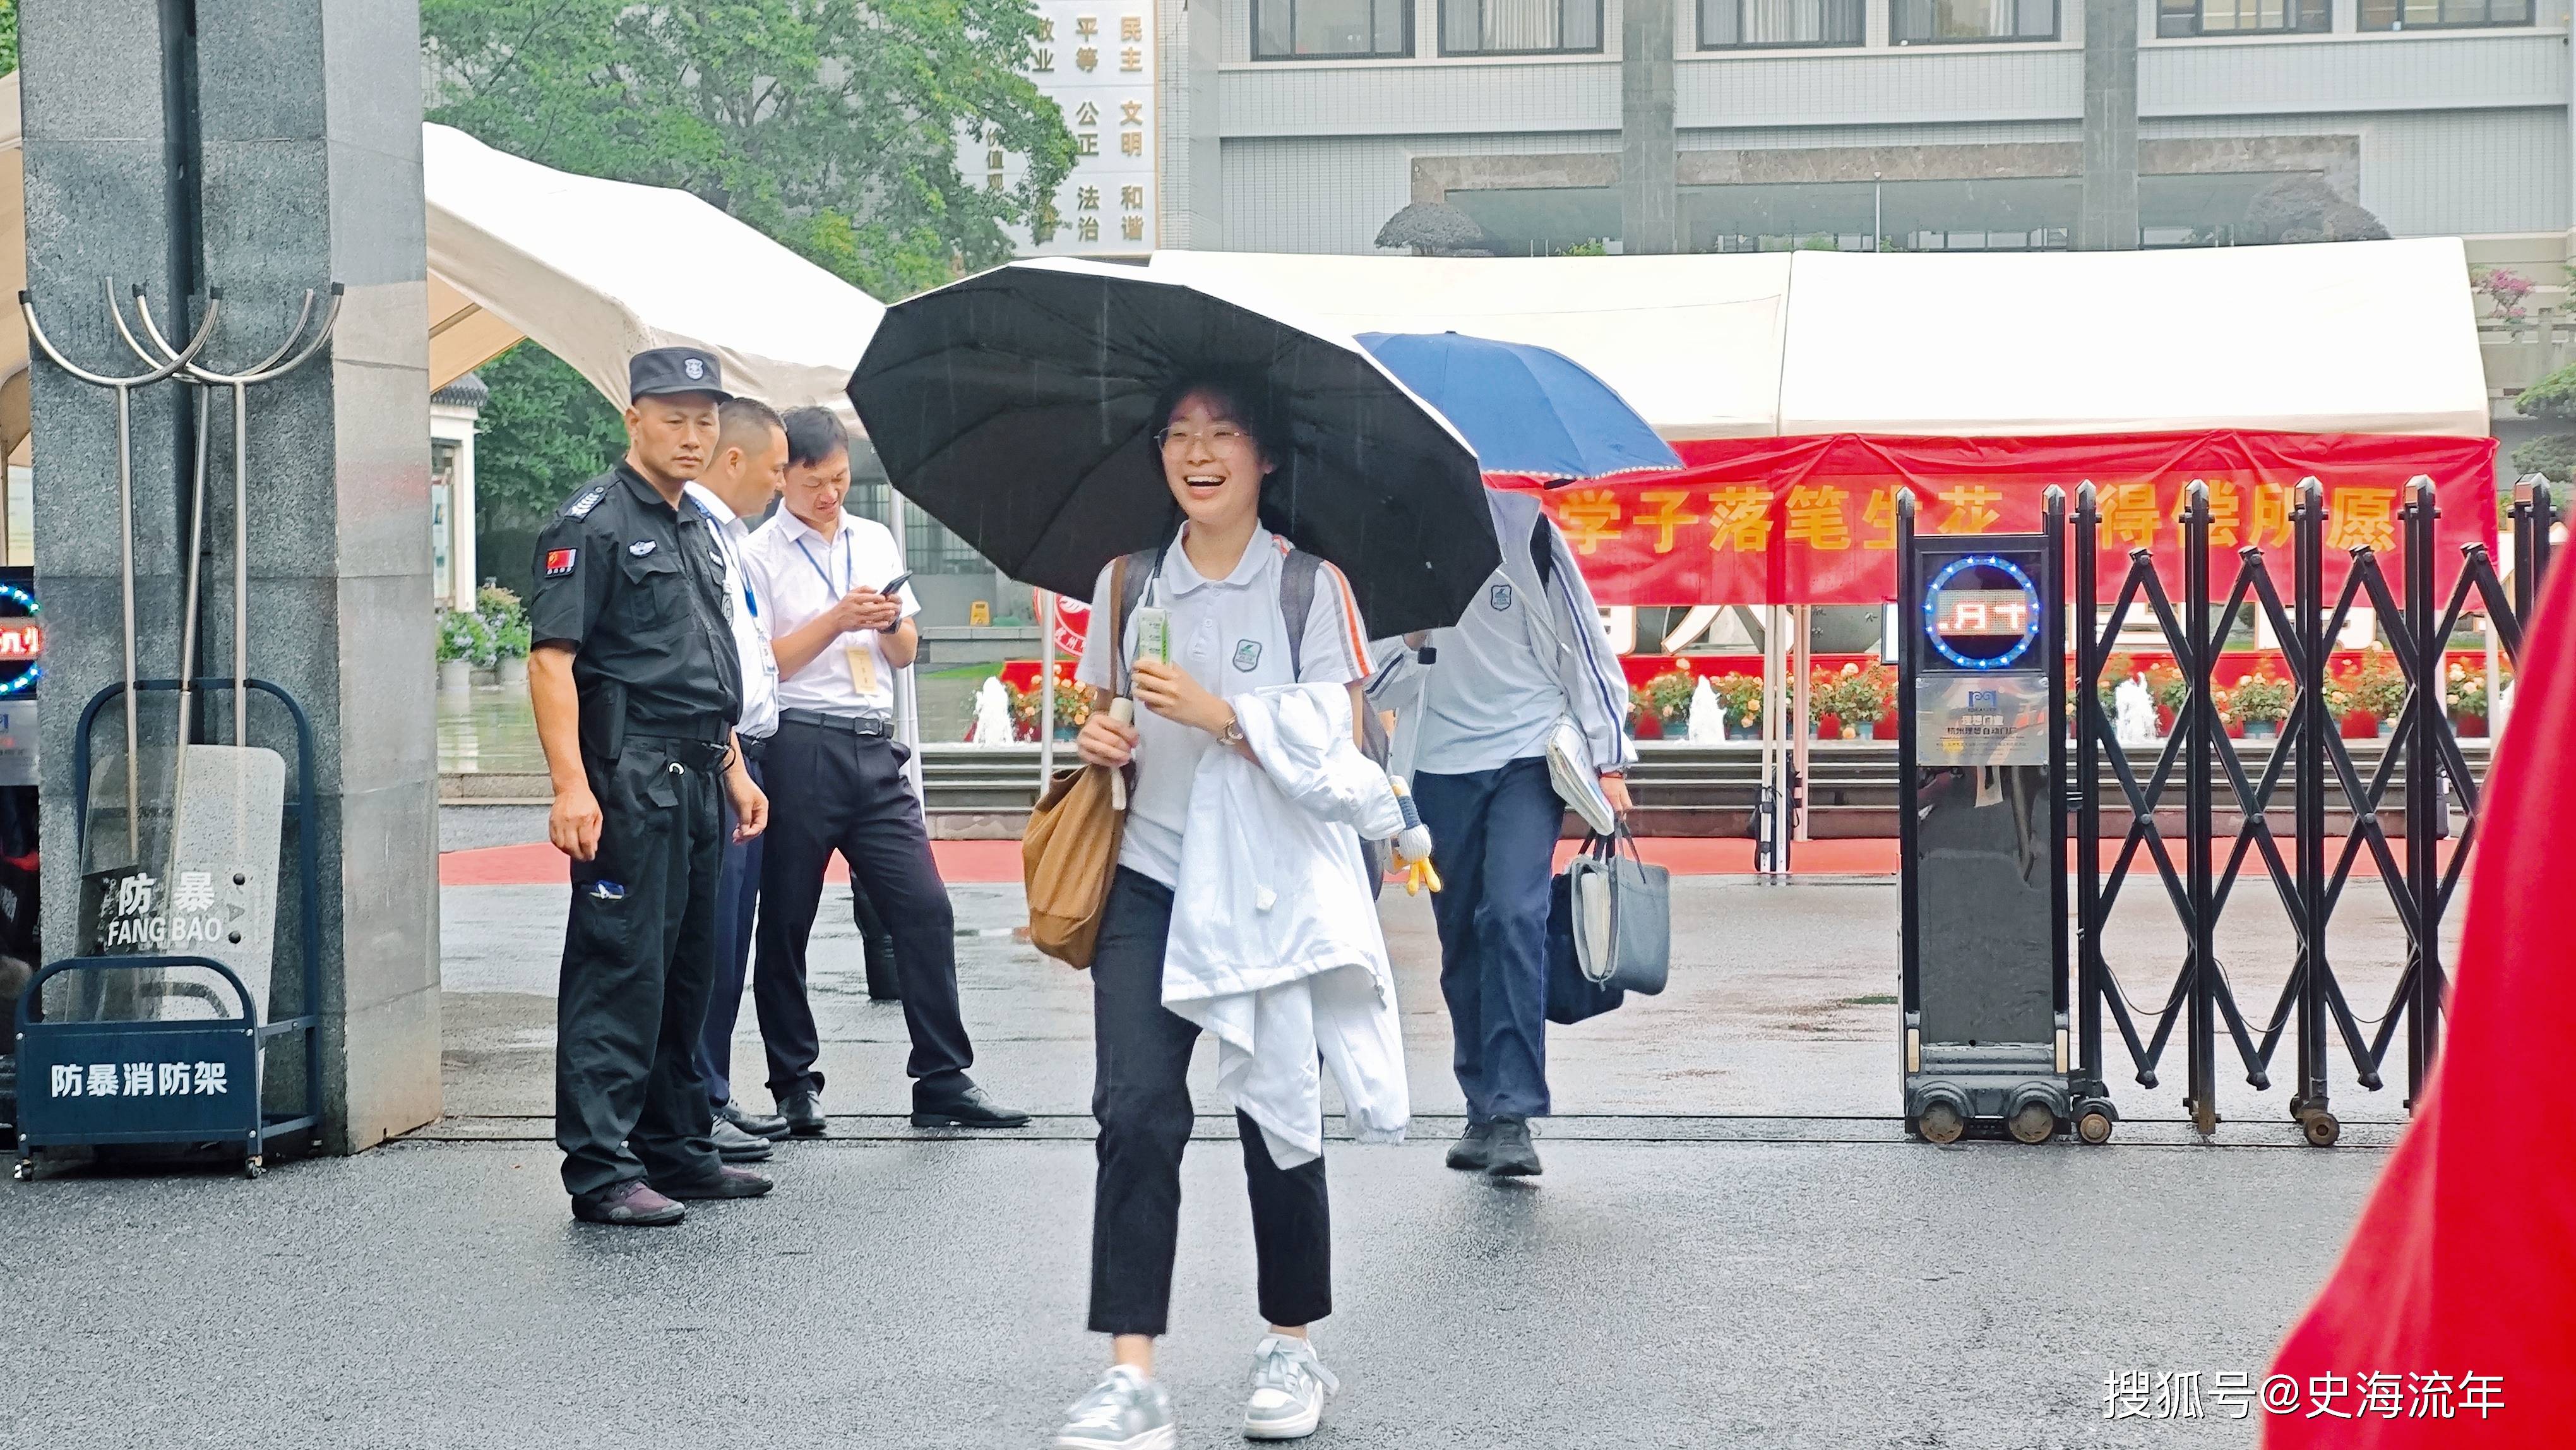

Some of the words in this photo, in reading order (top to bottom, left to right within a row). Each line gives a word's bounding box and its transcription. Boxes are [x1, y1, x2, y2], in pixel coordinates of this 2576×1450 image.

[1075, 17, 1099, 73] 平等
[1120, 16, 1143, 71] 民主
[1076, 101, 1099, 156] 公正
[1120, 100, 1143, 157] 文明
[1077, 186, 1099, 242] 法治
[1121, 185, 1143, 241] 和谐
[1558, 485, 2002, 554] 学子落笔生花
[2096, 479, 2397, 552] 得偿所愿
[107, 916, 167, 947] FANG
[172, 916, 222, 943] BAO
[51, 1061, 228, 1098] 防暴消防架
